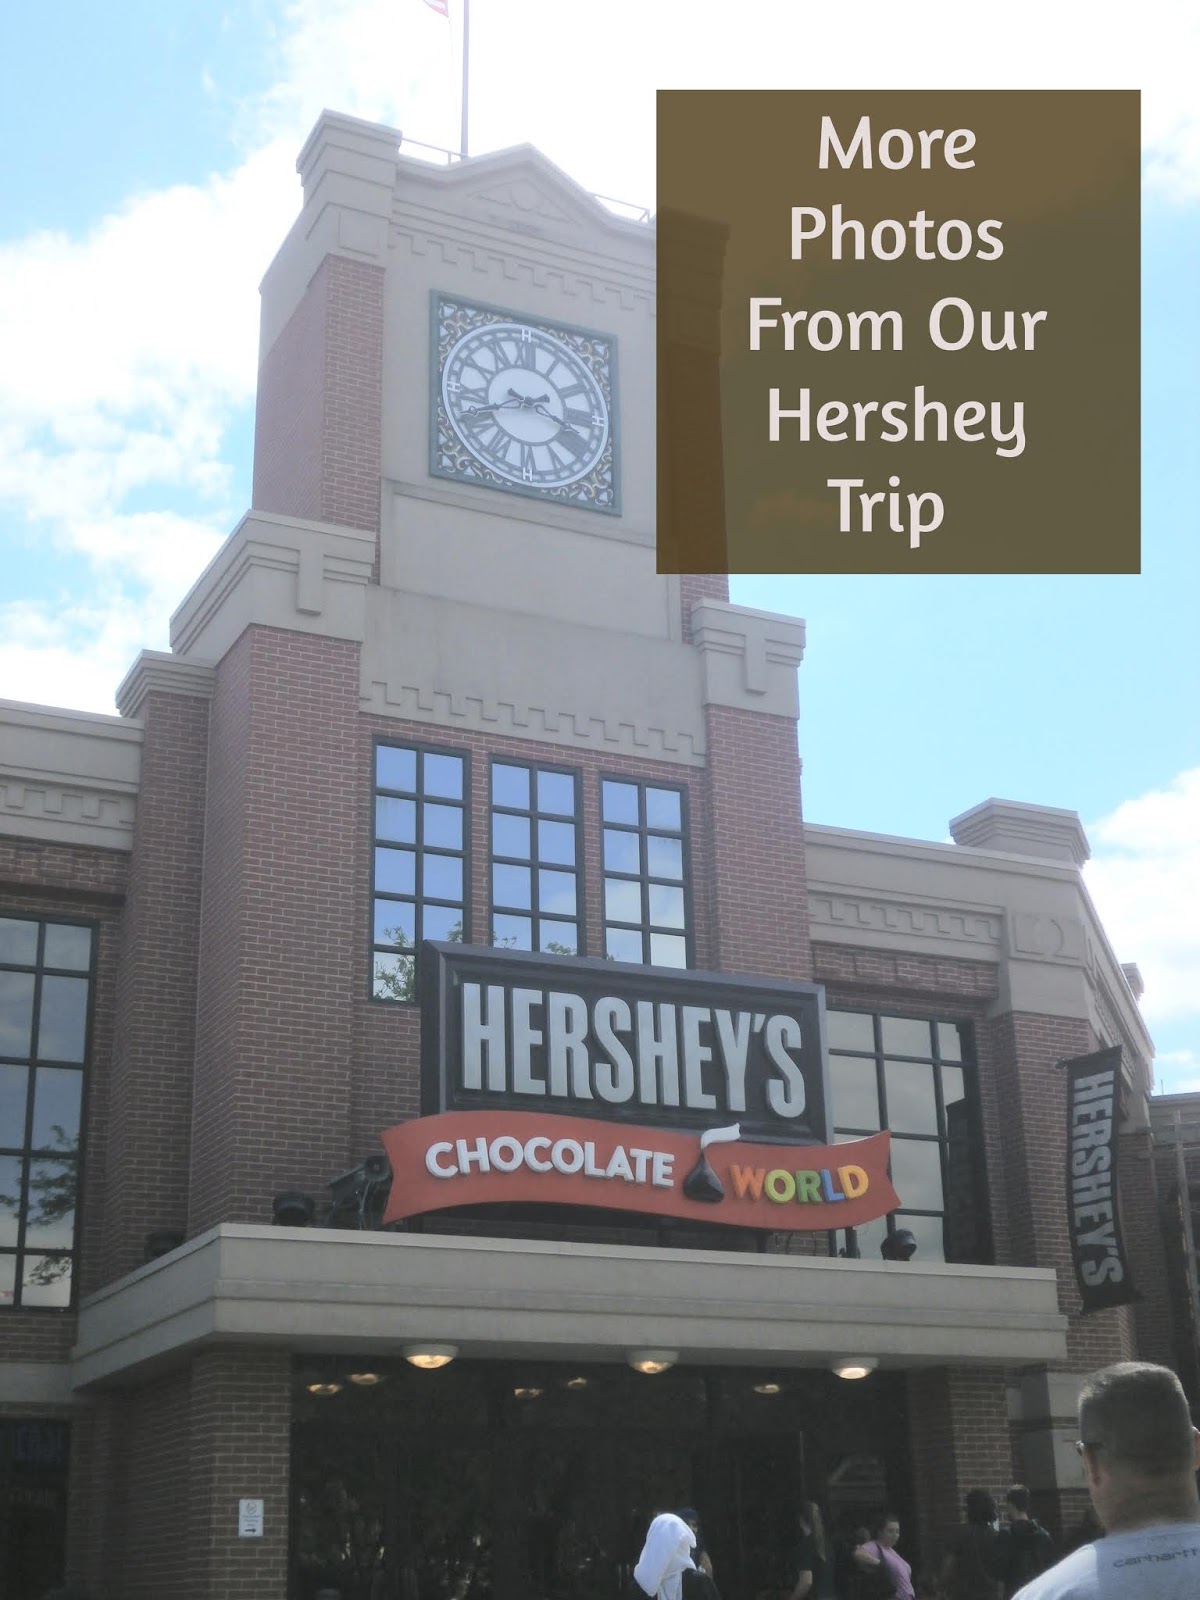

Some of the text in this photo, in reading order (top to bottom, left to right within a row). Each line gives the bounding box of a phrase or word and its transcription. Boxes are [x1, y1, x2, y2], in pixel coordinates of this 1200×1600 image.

[463, 983, 806, 1119] HERSHEY'S
[424, 1135, 870, 1204] CHOCOLATE WORLD
[1072, 1070, 1124, 1286] HERSHEY'S
[1113, 1548, 1198, 1568] carhartt
